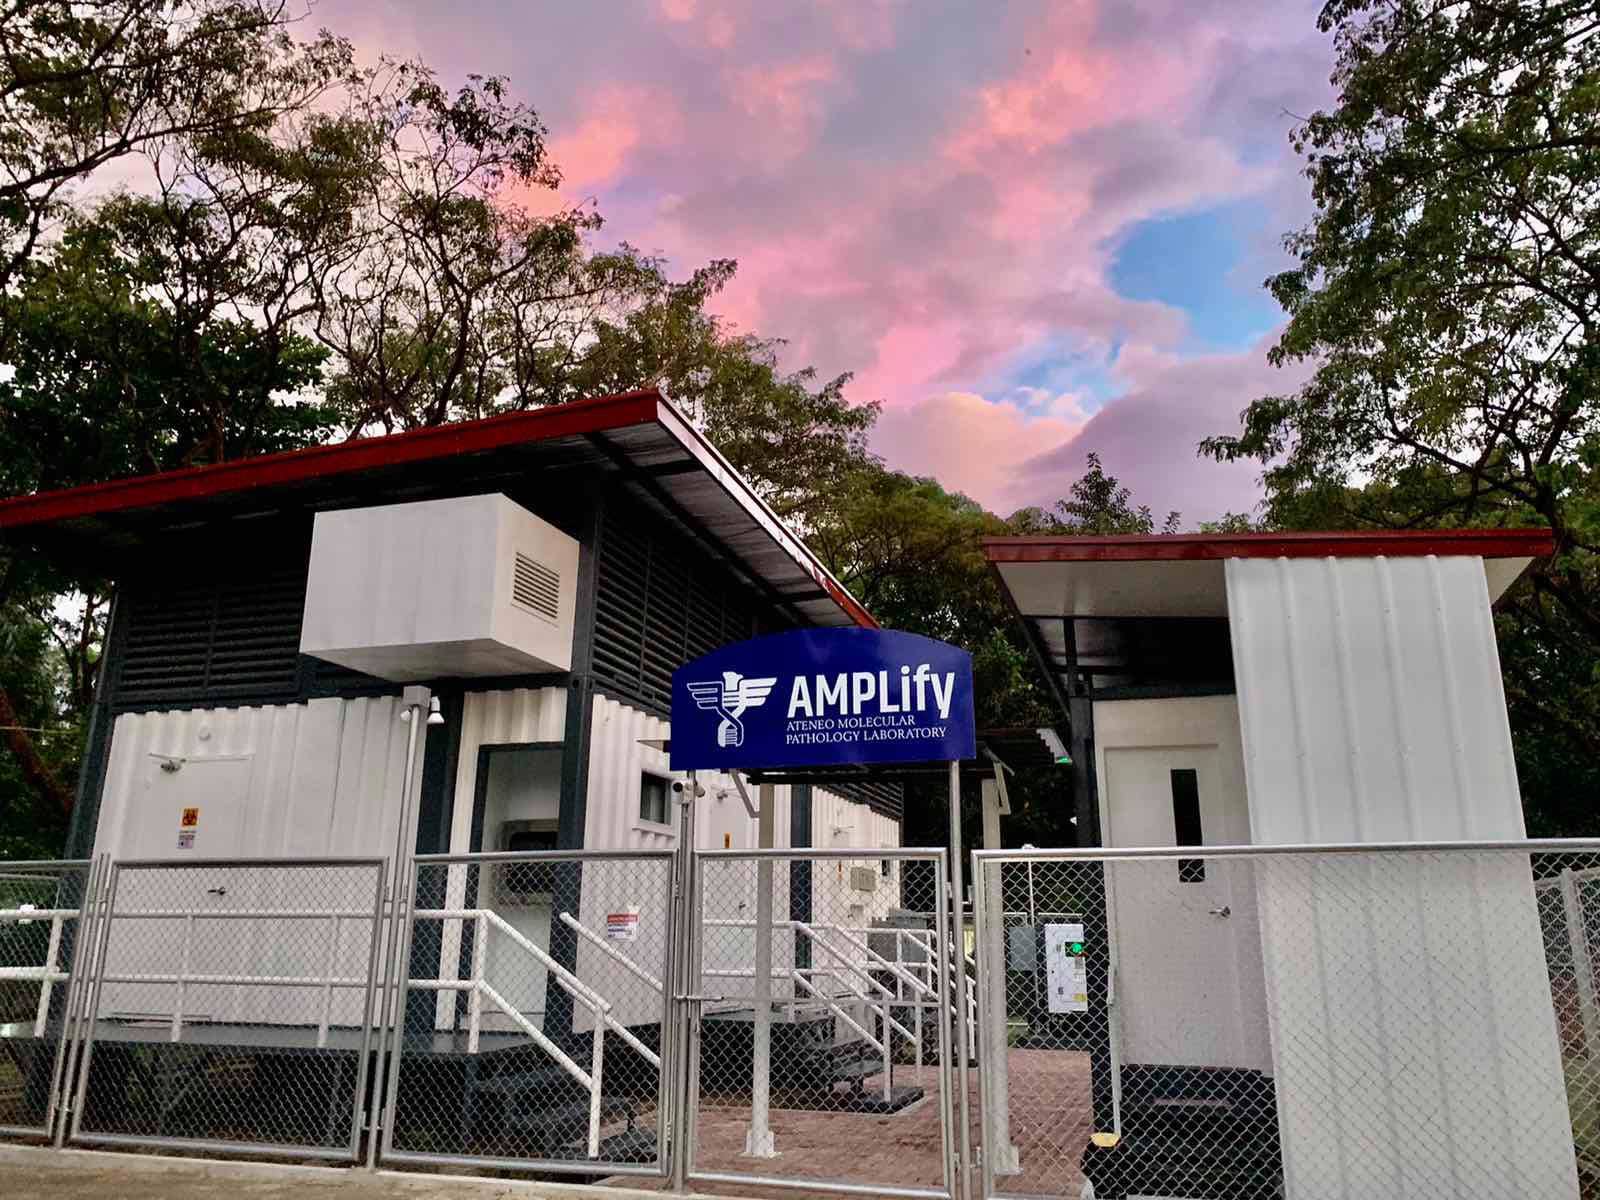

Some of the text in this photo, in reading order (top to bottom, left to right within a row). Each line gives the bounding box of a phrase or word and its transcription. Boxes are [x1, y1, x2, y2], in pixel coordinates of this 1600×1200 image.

[787, 664, 955, 719] AMPLify
[787, 715, 916, 731] ATENEO MOLECULAR
[787, 727, 946, 744] PATHOLOGY LABORATORY
